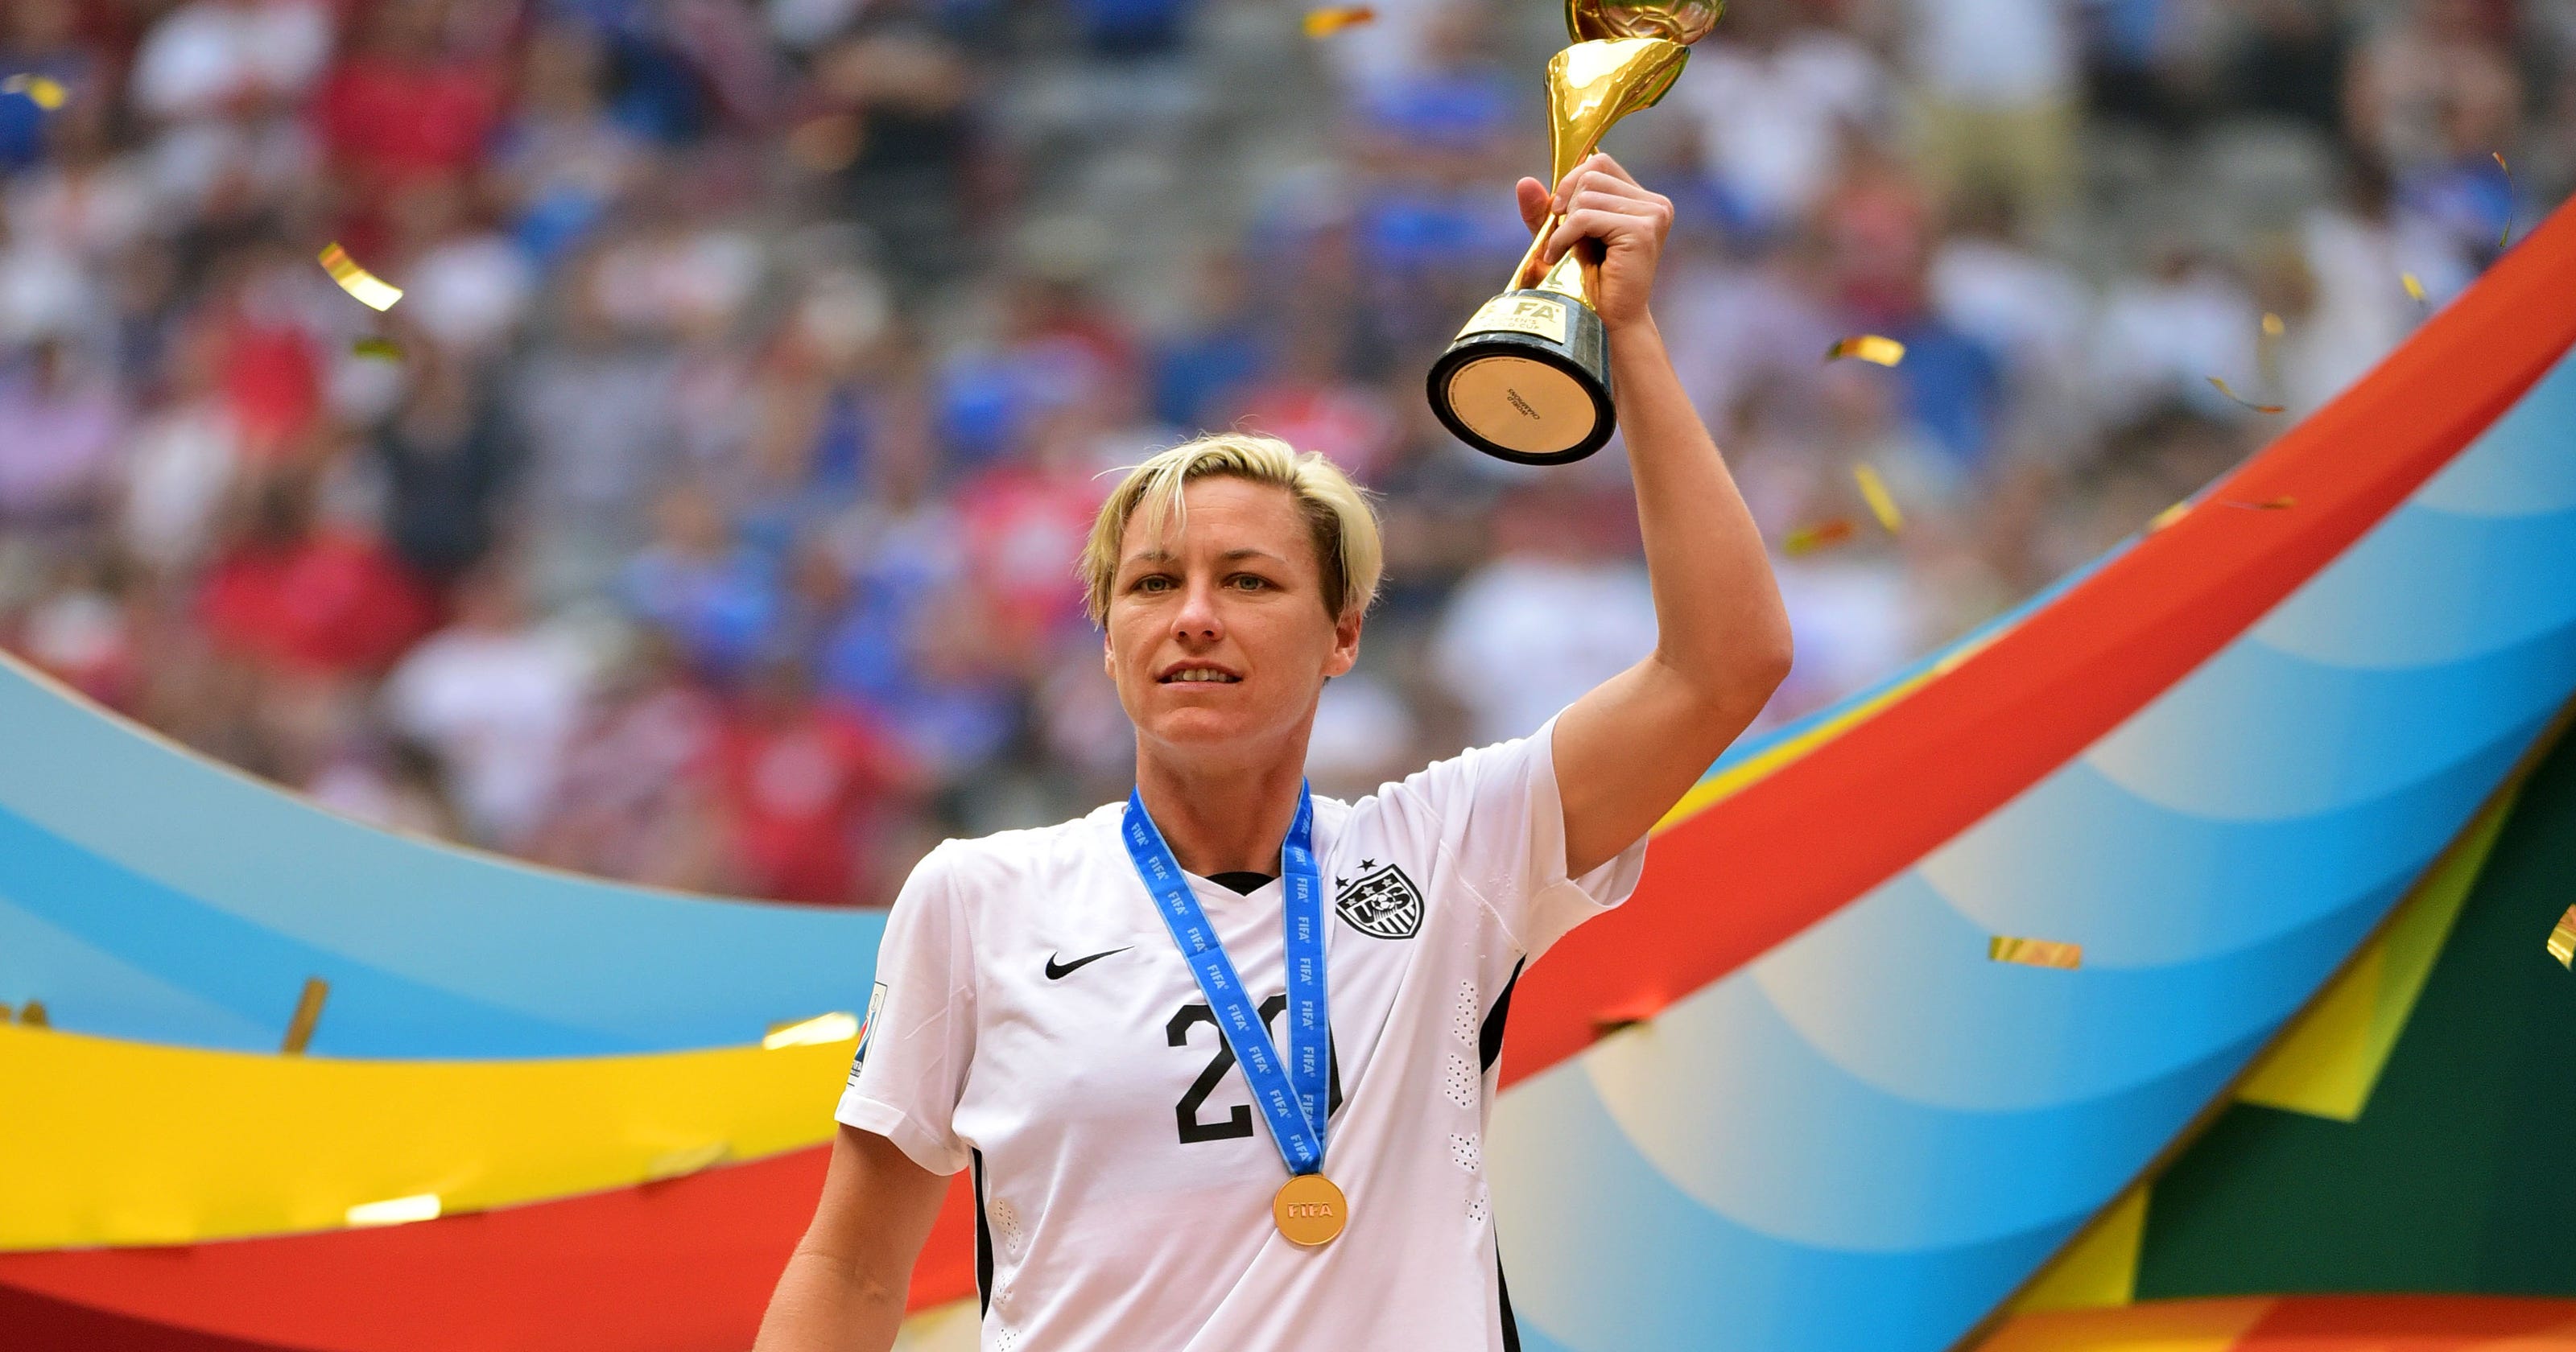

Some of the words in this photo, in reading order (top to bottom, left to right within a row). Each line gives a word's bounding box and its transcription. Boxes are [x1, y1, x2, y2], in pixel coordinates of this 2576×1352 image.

[1480, 302, 1557, 323] FFA
[1297, 878, 1308, 900] FIFA
[1298, 917, 1310, 941] FIFA
[1300, 957, 1311, 983] FIFA
[1131, 822, 1147, 847] FIFA
[1149, 855, 1166, 881] FIFA
[1167, 891, 1187, 916] FIFA
[1187, 927, 1206, 953] FIFA
[1207, 963, 1225, 990] FIFA
[1227, 1004, 1245, 1031] FIFA
[1249, 1046, 1266, 1074] FIFA
[1269, 1090, 1288, 1118] FIFA
[1290, 1133, 1310, 1162] FIFA
[1302, 1000, 1314, 1027] FIFA
[1303, 1046, 1315, 1075] FIFA
[1287, 1202, 1334, 1218] FIFA
